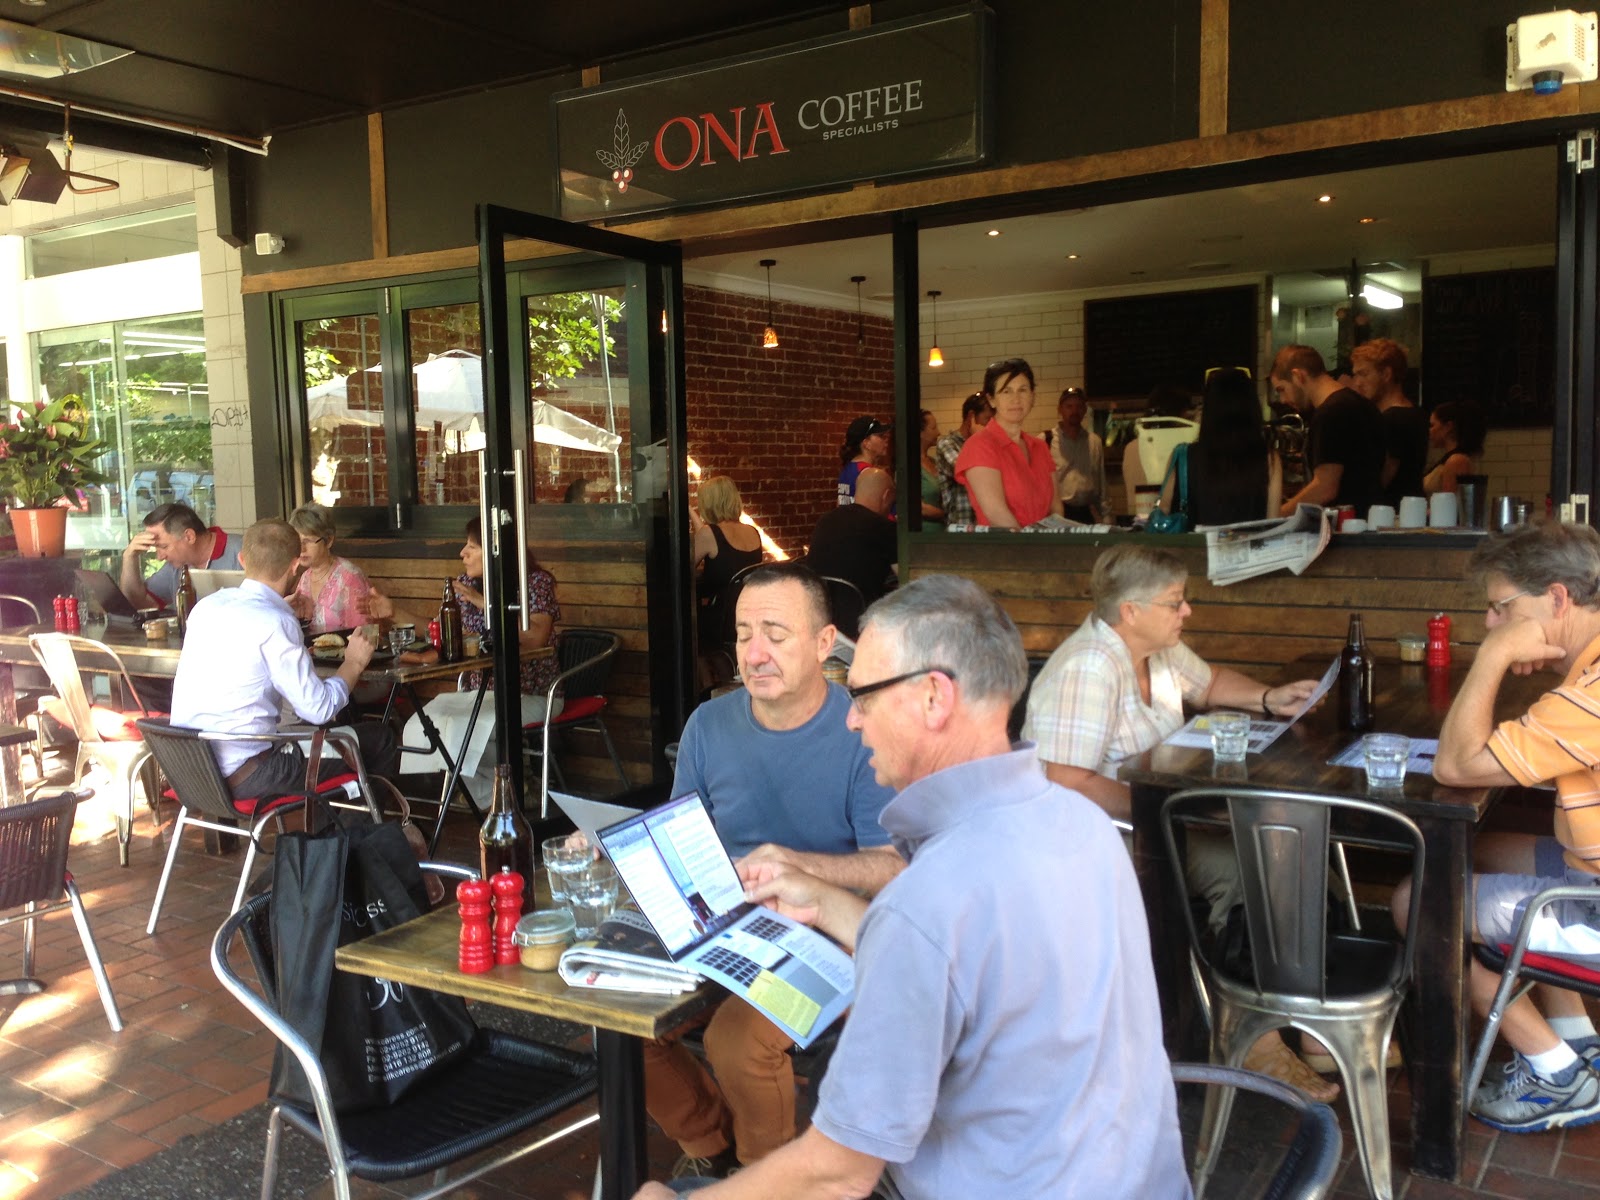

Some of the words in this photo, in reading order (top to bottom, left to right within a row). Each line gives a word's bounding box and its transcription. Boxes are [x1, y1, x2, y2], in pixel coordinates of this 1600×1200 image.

[654, 102, 790, 171] ONA
[798, 79, 923, 130] COFFEE
[823, 119, 899, 140] SPECIALISTS
